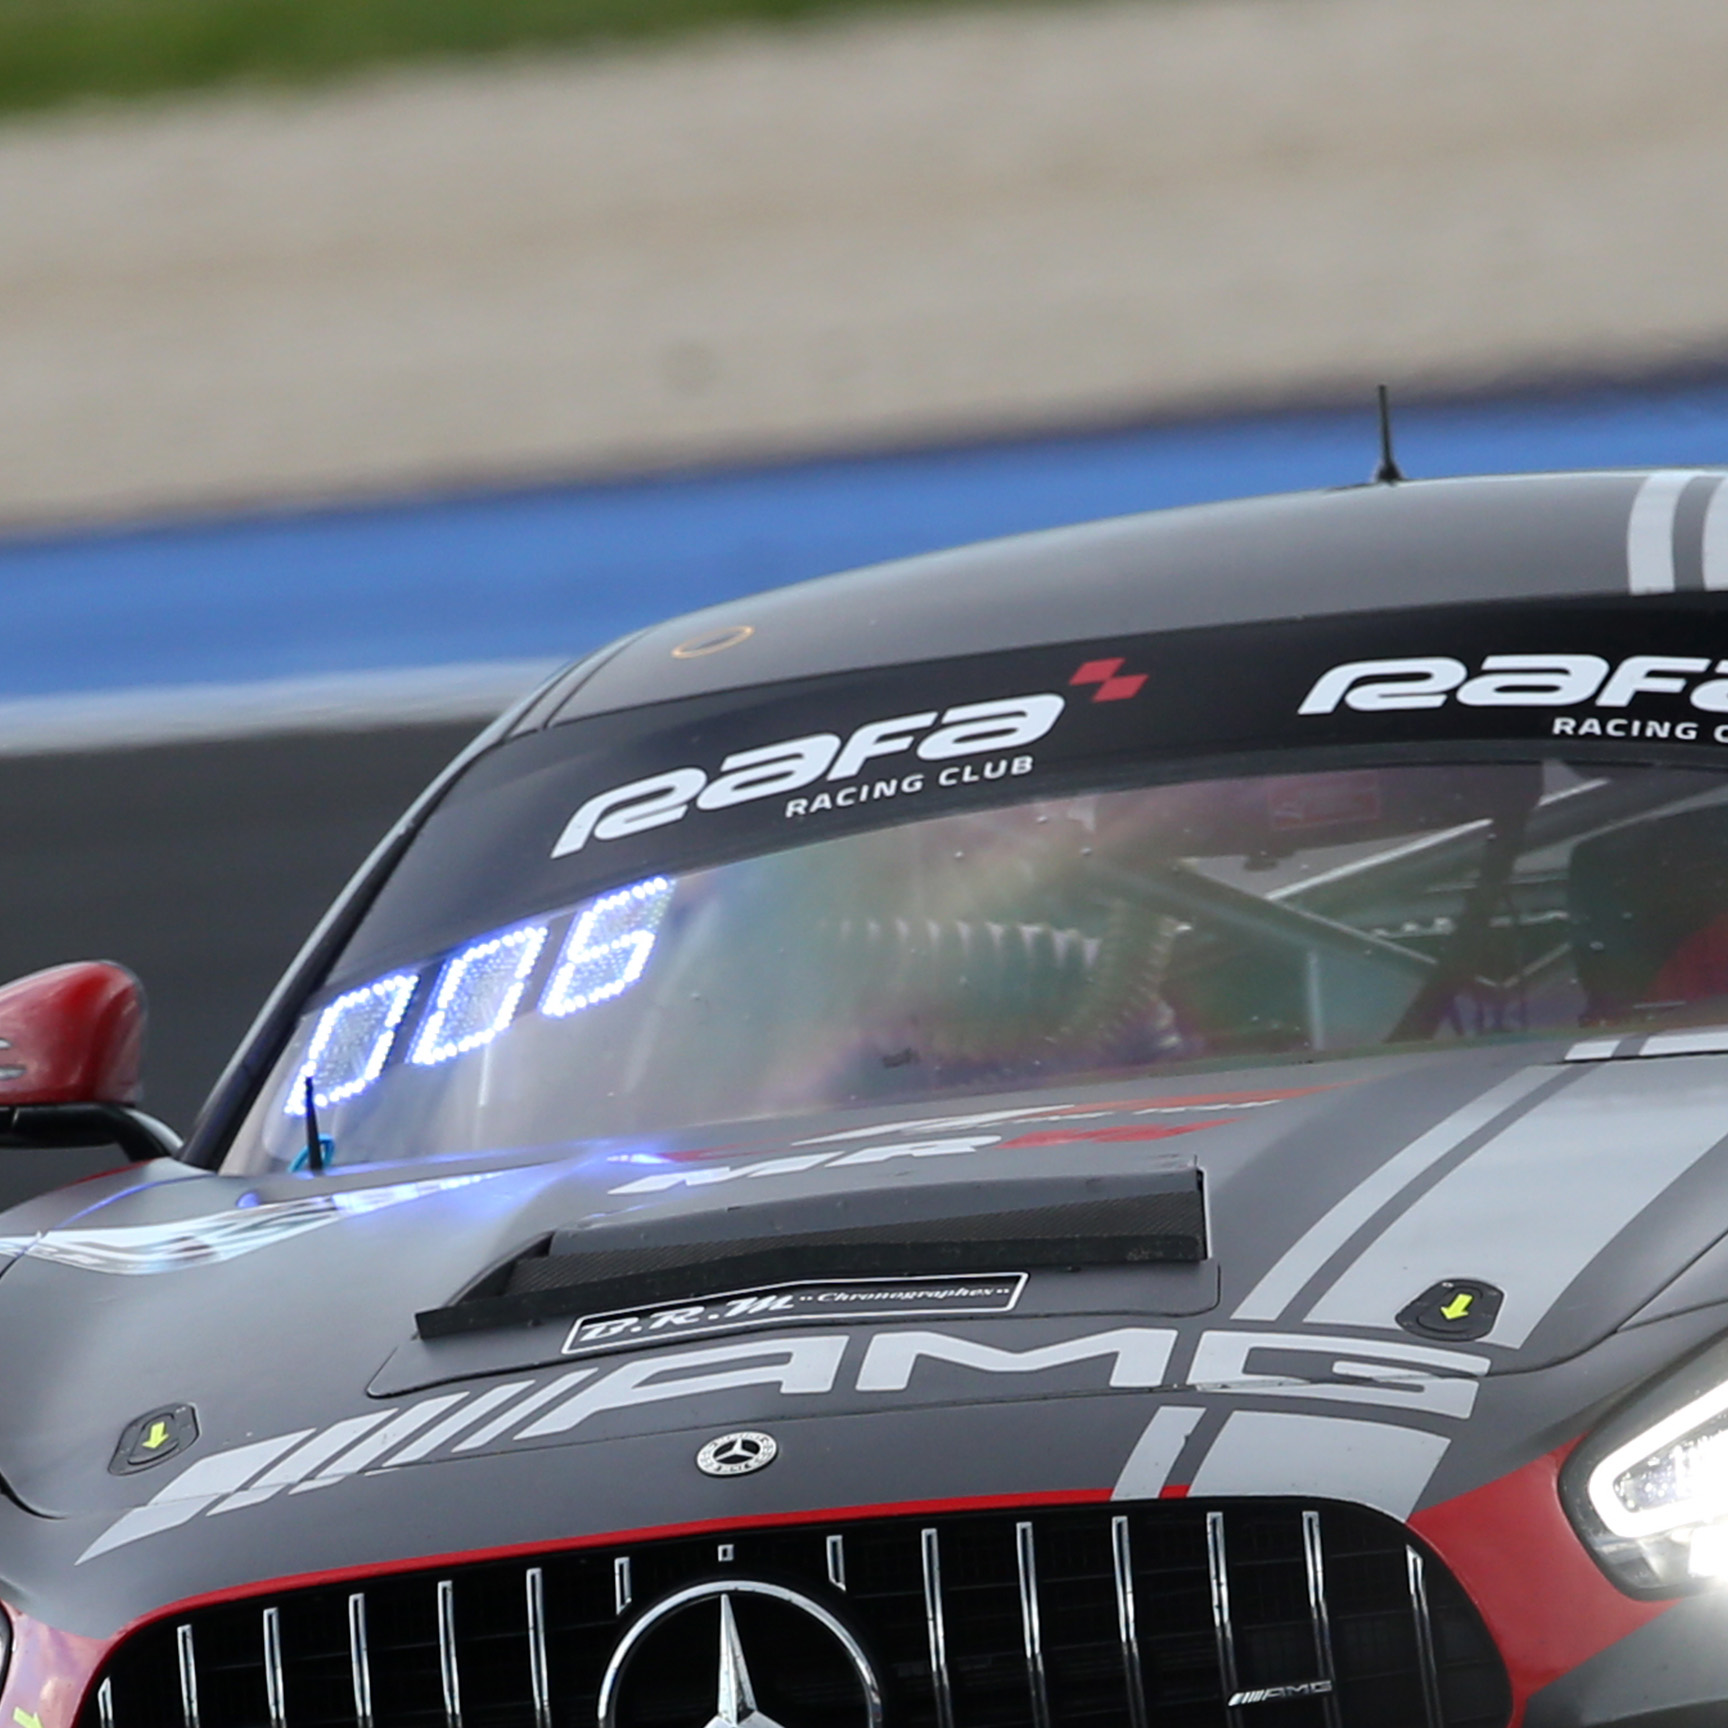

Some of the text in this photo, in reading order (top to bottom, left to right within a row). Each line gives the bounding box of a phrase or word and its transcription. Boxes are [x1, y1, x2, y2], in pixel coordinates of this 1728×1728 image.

[1552, 717, 1699, 742] RACING
[784, 756, 1034, 819] RACING CLUB
[1262, 1680, 1332, 1702] AMG
